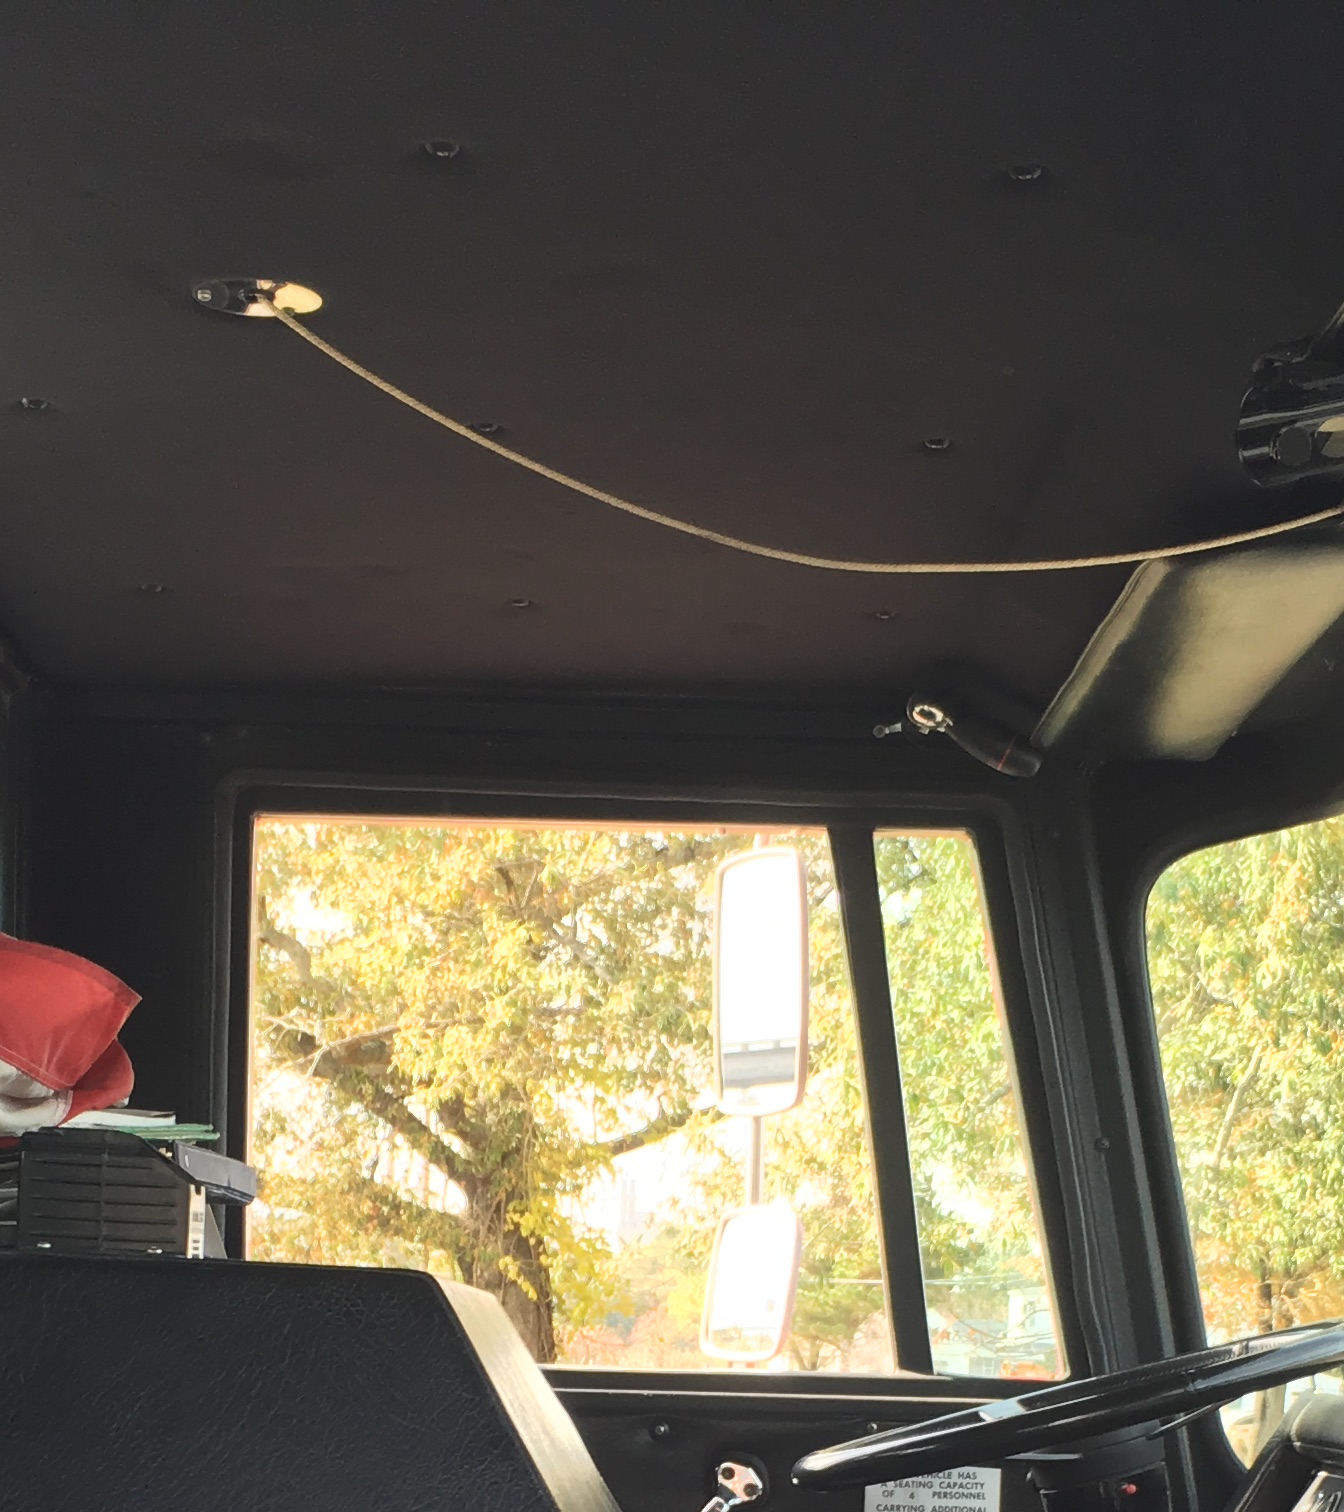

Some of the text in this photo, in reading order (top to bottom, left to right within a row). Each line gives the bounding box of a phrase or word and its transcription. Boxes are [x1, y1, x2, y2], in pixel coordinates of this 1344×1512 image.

[957, 1471, 978, 1480] HAS
[893, 1480, 934, 1489] SEATING
[938, 1480, 985, 1490] CAPACITY
[882, 1489, 987, 1500] OF 4 PERSONNEL
[876, 1504, 925, 1512] CARRYING
